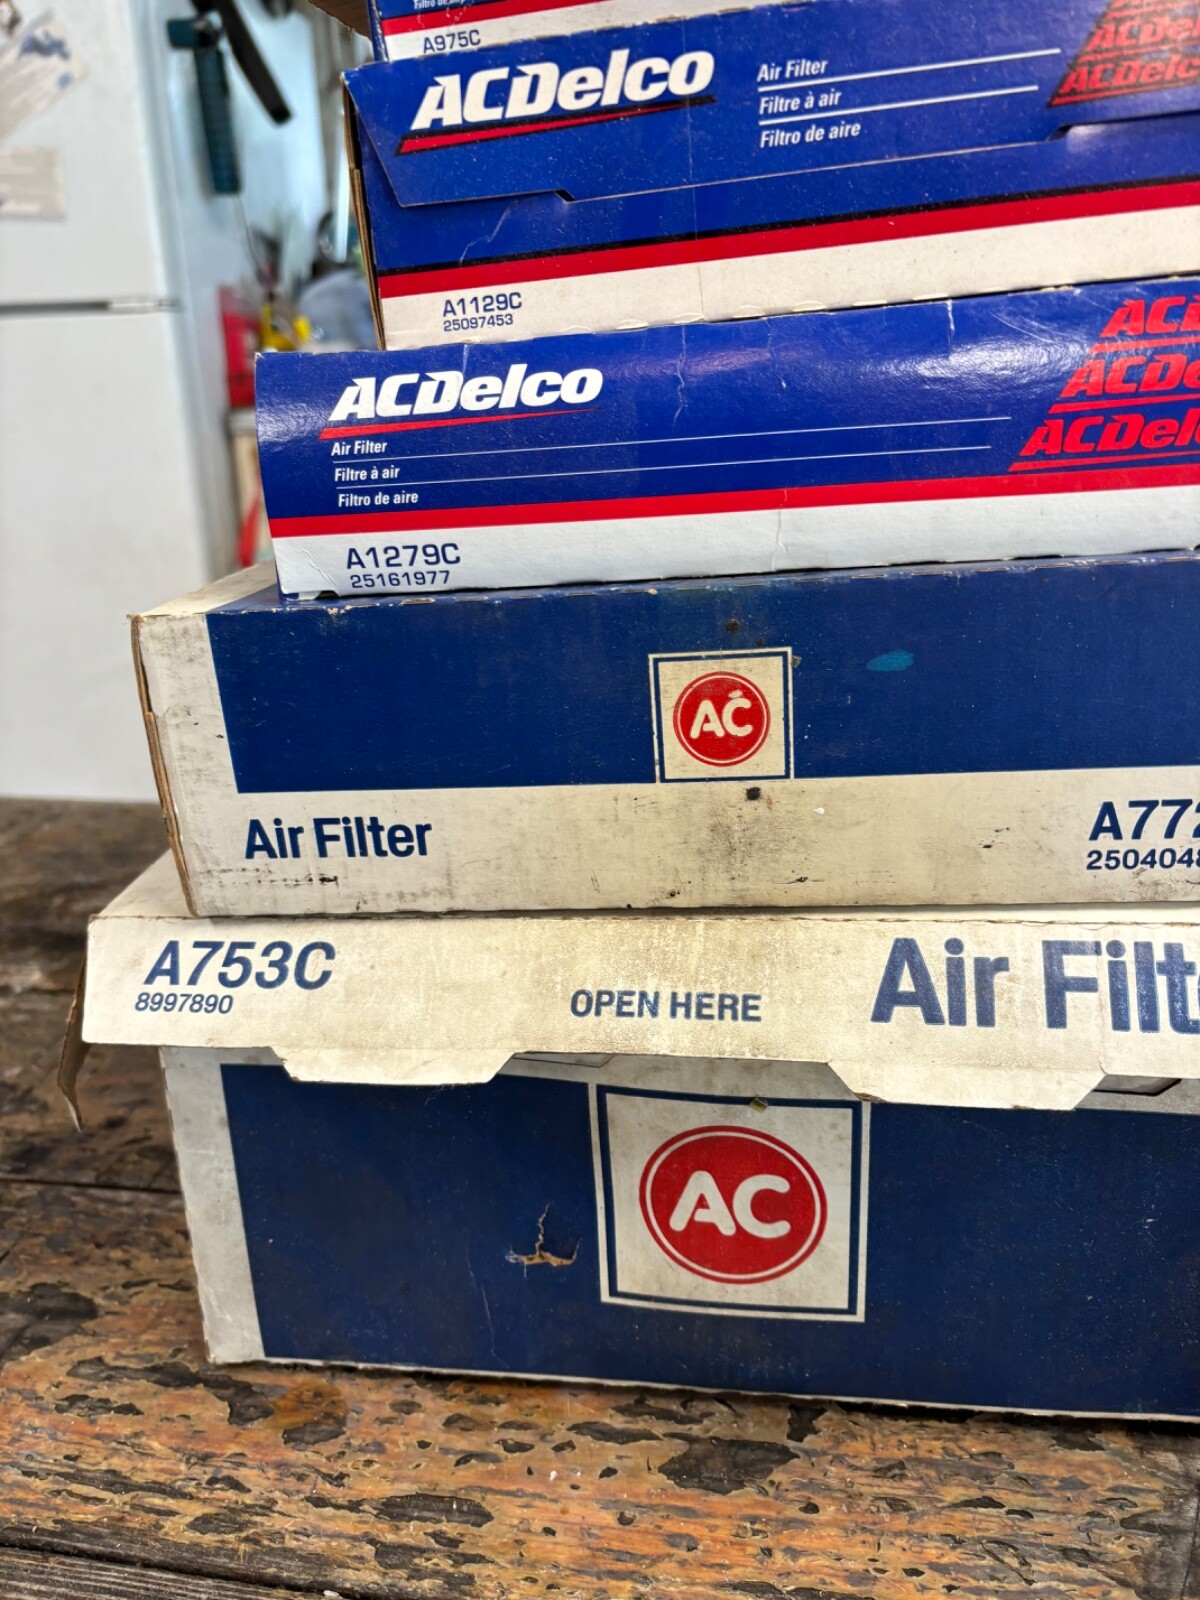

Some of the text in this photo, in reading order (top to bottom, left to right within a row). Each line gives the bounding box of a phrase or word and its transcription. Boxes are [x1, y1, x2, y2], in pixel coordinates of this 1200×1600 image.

[423, 29, 481, 54] A975C
[756, 59, 828, 82] Air Filter
[410, 48, 715, 131] ACDelco
[759, 88, 842, 115] Filtre à air
[760, 120, 861, 148] Filtro de aire
[442, 292, 522, 318] A1129C
[443, 313, 514, 332] 25097453
[328, 363, 604, 422] ACDelco
[1018, 407, 1200, 457] ACDel
[331, 439, 388, 456] Air Filter
[334, 464, 400, 482] Filtre à air
[338, 489, 419, 508] Filtro de aire
[346, 542, 461, 570] A1279C
[350, 570, 451, 589] 25161977
[689, 697, 754, 740] AC
[1088, 798, 1200, 841] A77
[245, 816, 432, 860] Air Filter
[1086, 847, 1200, 871] 250404
[143, 940, 336, 990] A753C
[869, 936, 1200, 1034] Air Filt
[134, 992, 234, 1014] 8997890
[569, 988, 763, 1023] OPEN HERE
[668, 1169, 792, 1239] AC
